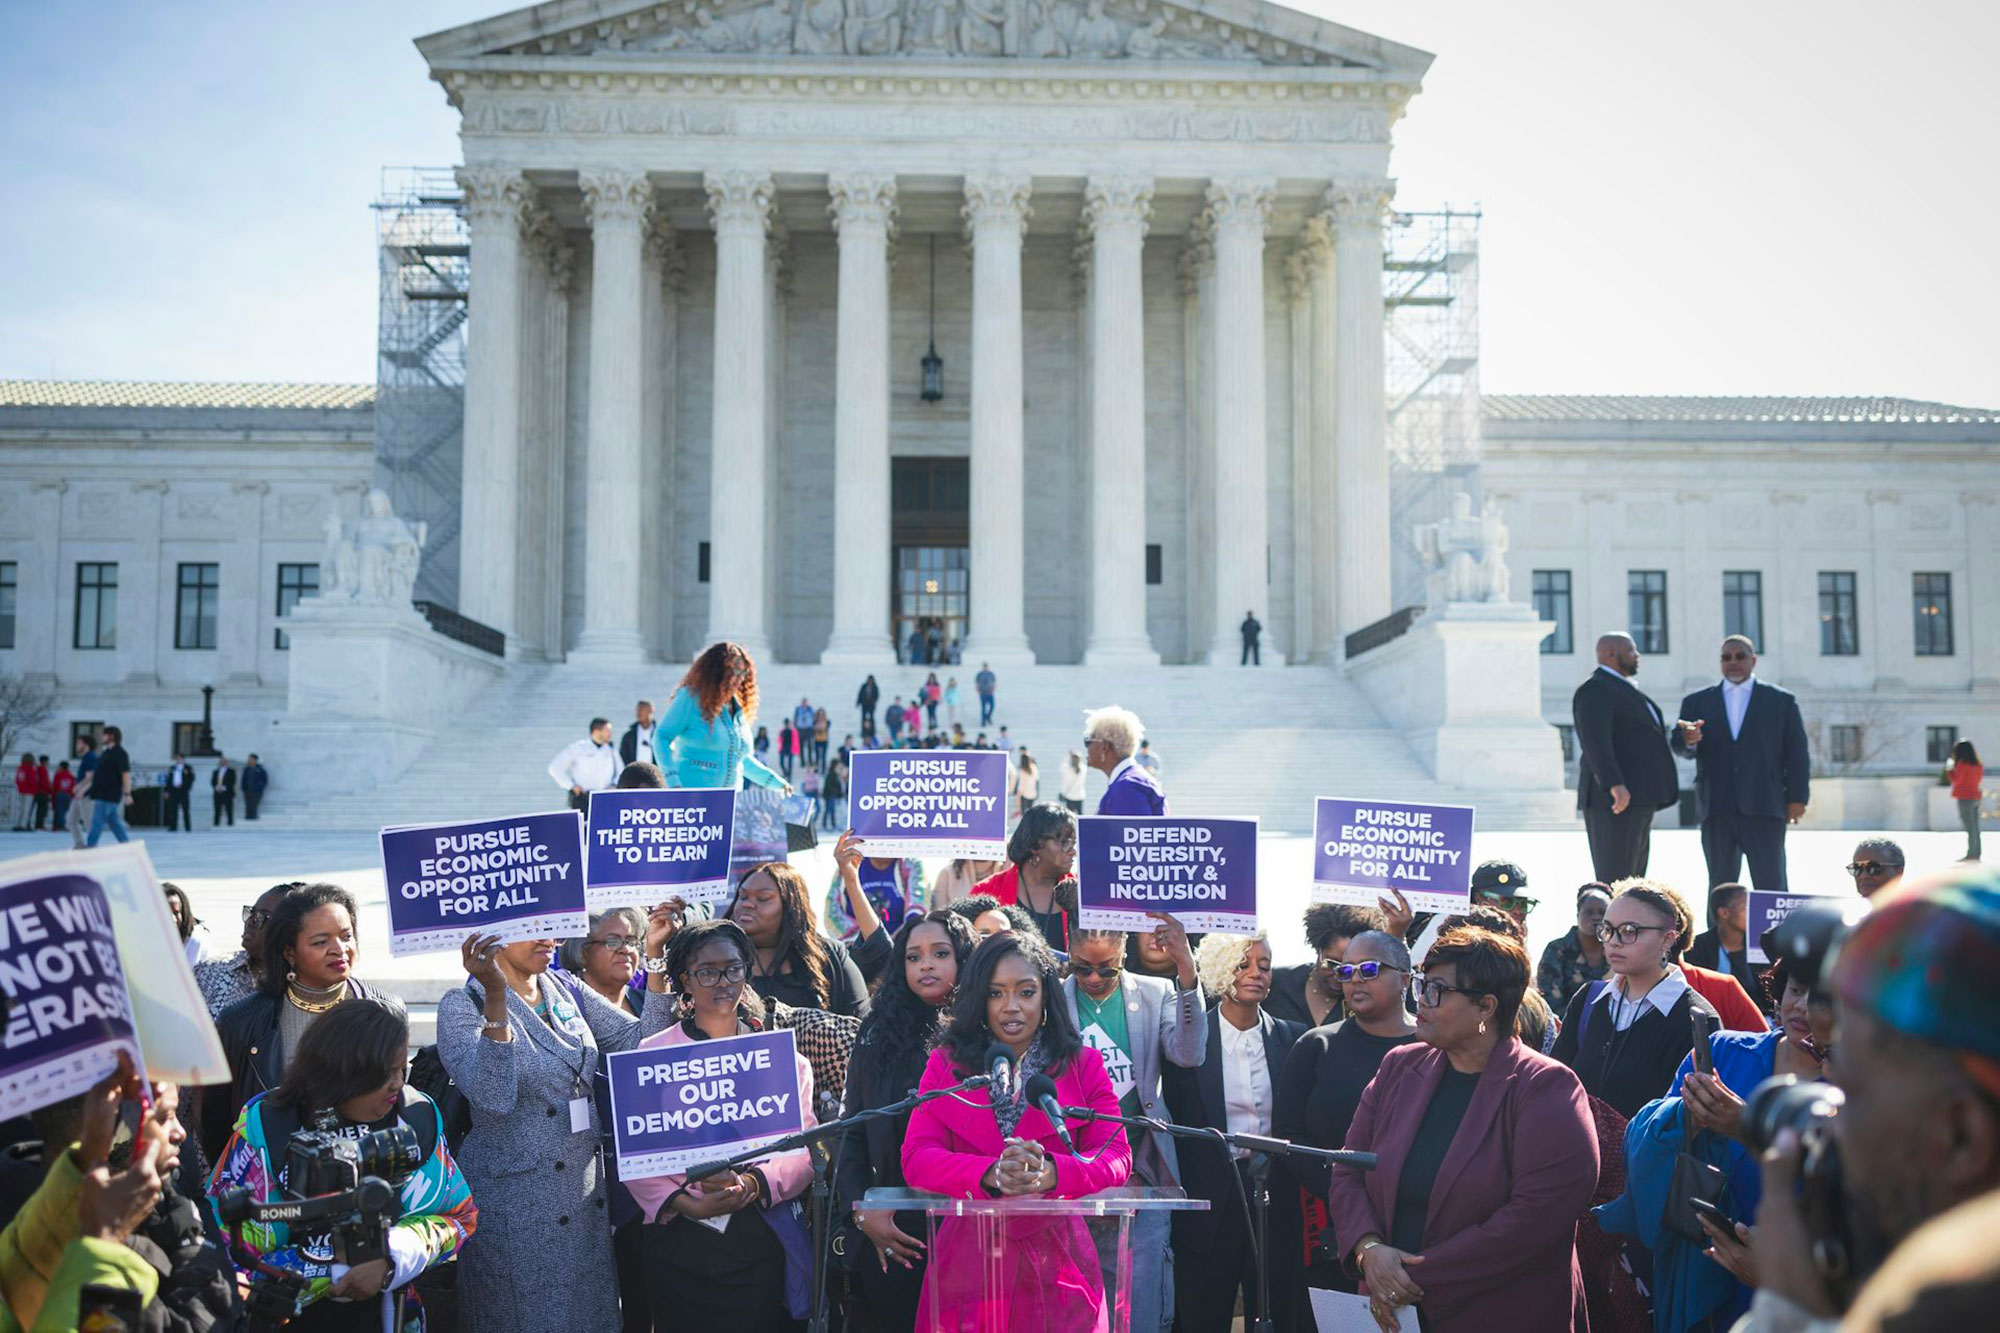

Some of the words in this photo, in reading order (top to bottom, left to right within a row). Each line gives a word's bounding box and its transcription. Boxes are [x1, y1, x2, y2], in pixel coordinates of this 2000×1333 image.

[889, 760, 967, 776] PURSUE
[875, 776, 981, 794] ECONOMIC
[858, 795, 997, 813] OPPORTUNITY
[619, 807, 707, 826] PROTECT
[886, 812, 927, 828] FOR
[931, 813, 969, 829] ALL
[1355, 808, 1432, 829] PURSUE
[434, 825, 530, 856] PURSUE
[597, 828, 635, 847] THE
[638, 825, 724, 844] FREEDOM
[1123, 827, 1212, 844] DEFEND
[1341, 825, 1445, 847] ECONOMIC
[420, 844, 549, 877] ECONOMIC
[614, 846, 642, 864] TO
[646, 844, 708, 863] LEARN
[1109, 845, 1227, 865] DIVERSITY,
[1324, 841, 1462, 866] OPPORTUNITY
[400, 862, 571, 900] OPPORTUNITY
[1118, 864, 1200, 882] EQUITY
[1202, 864, 1218, 882] &
[1350, 860, 1389, 878] FOR
[1392, 865, 1432, 881] ALL
[439, 890, 490, 916] FOR
[493, 886, 539, 911] ALL
[1109, 883, 1227, 901] INCLUSION
[42, 894, 114, 939] WILL
[0, 939, 94, 998] NOT
[637, 1048, 772, 1087] PRESERVE
[1108, 1064, 1136, 1083] ATE
[679, 1078, 736, 1105] OUR
[626, 1093, 790, 1137] DEMOCRACY
[260, 1206, 302, 1220] RONIN
